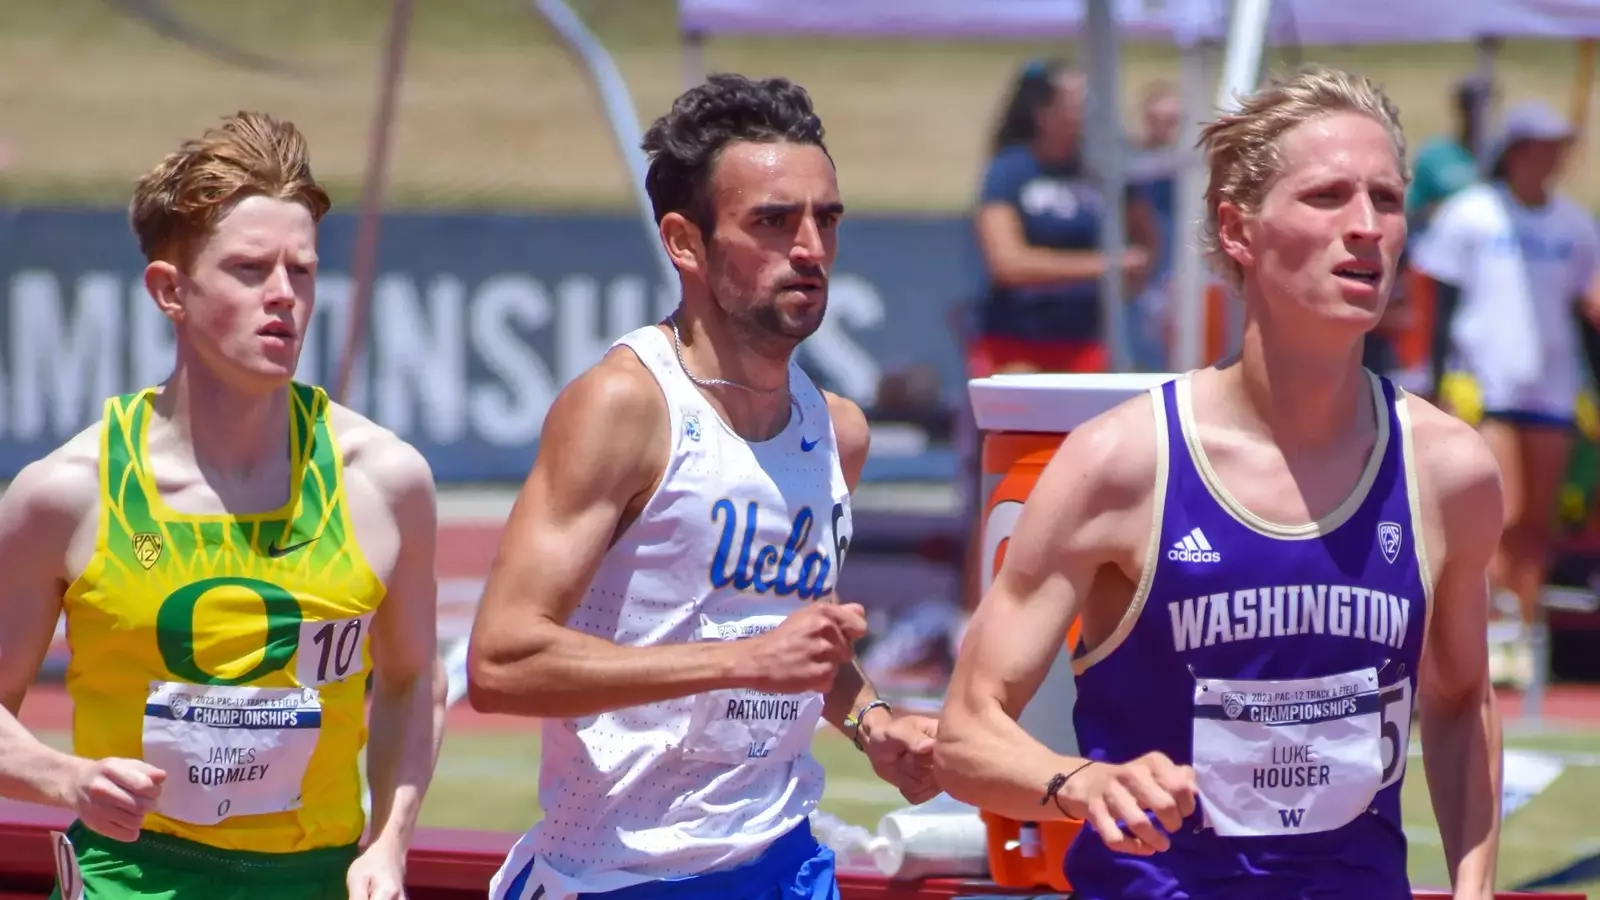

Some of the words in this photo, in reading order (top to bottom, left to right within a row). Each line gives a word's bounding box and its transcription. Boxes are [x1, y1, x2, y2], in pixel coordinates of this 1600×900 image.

[141, 550, 154, 561] 12
[1168, 548, 1221, 562] adidas
[1385, 540, 1395, 553] 12
[1167, 584, 1410, 652] WASHINGTON
[313, 618, 361, 682] 10
[196, 696, 214, 704] 2023
[247, 699, 269, 707] TRACK
[278, 699, 299, 708] FIELD
[1252, 693, 1272, 703] 2023
[1306, 689, 1329, 700] TRACK
[1340, 684, 1358, 695] FIELD
[194, 707, 298, 726] CHAMPIONSHIPS
[726, 699, 799, 720] RATKOVICH
[1250, 698, 1357, 722] CHAMPIONSHIPS
[206, 747, 256, 765] JAMES
[1272, 744, 1314, 765] LUKE
[188, 764, 269, 786] GORMLEY
[1253, 765, 1330, 788] HOUSER
[1278, 808, 1305, 828] W
